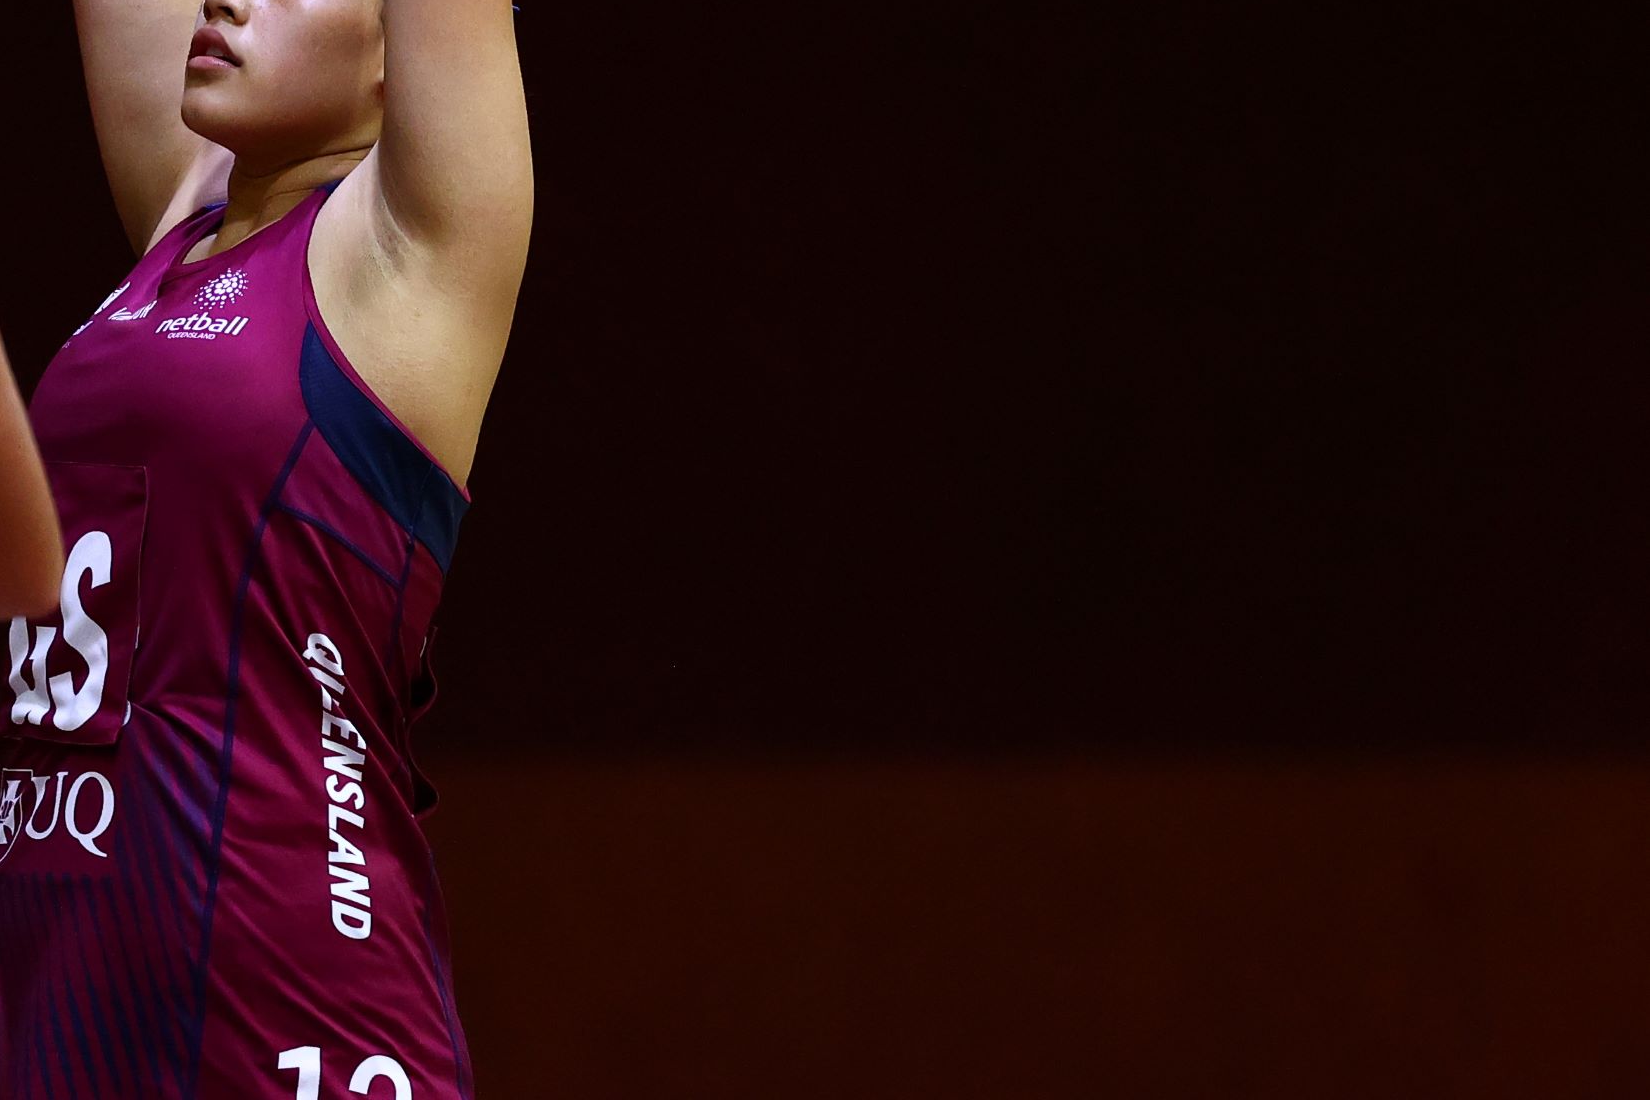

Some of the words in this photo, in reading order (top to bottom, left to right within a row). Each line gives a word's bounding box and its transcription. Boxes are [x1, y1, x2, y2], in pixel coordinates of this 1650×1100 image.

[155, 312, 249, 336] netball
[167, 331, 217, 341] QUEENSLAND
[25, 769, 115, 858] UQ
